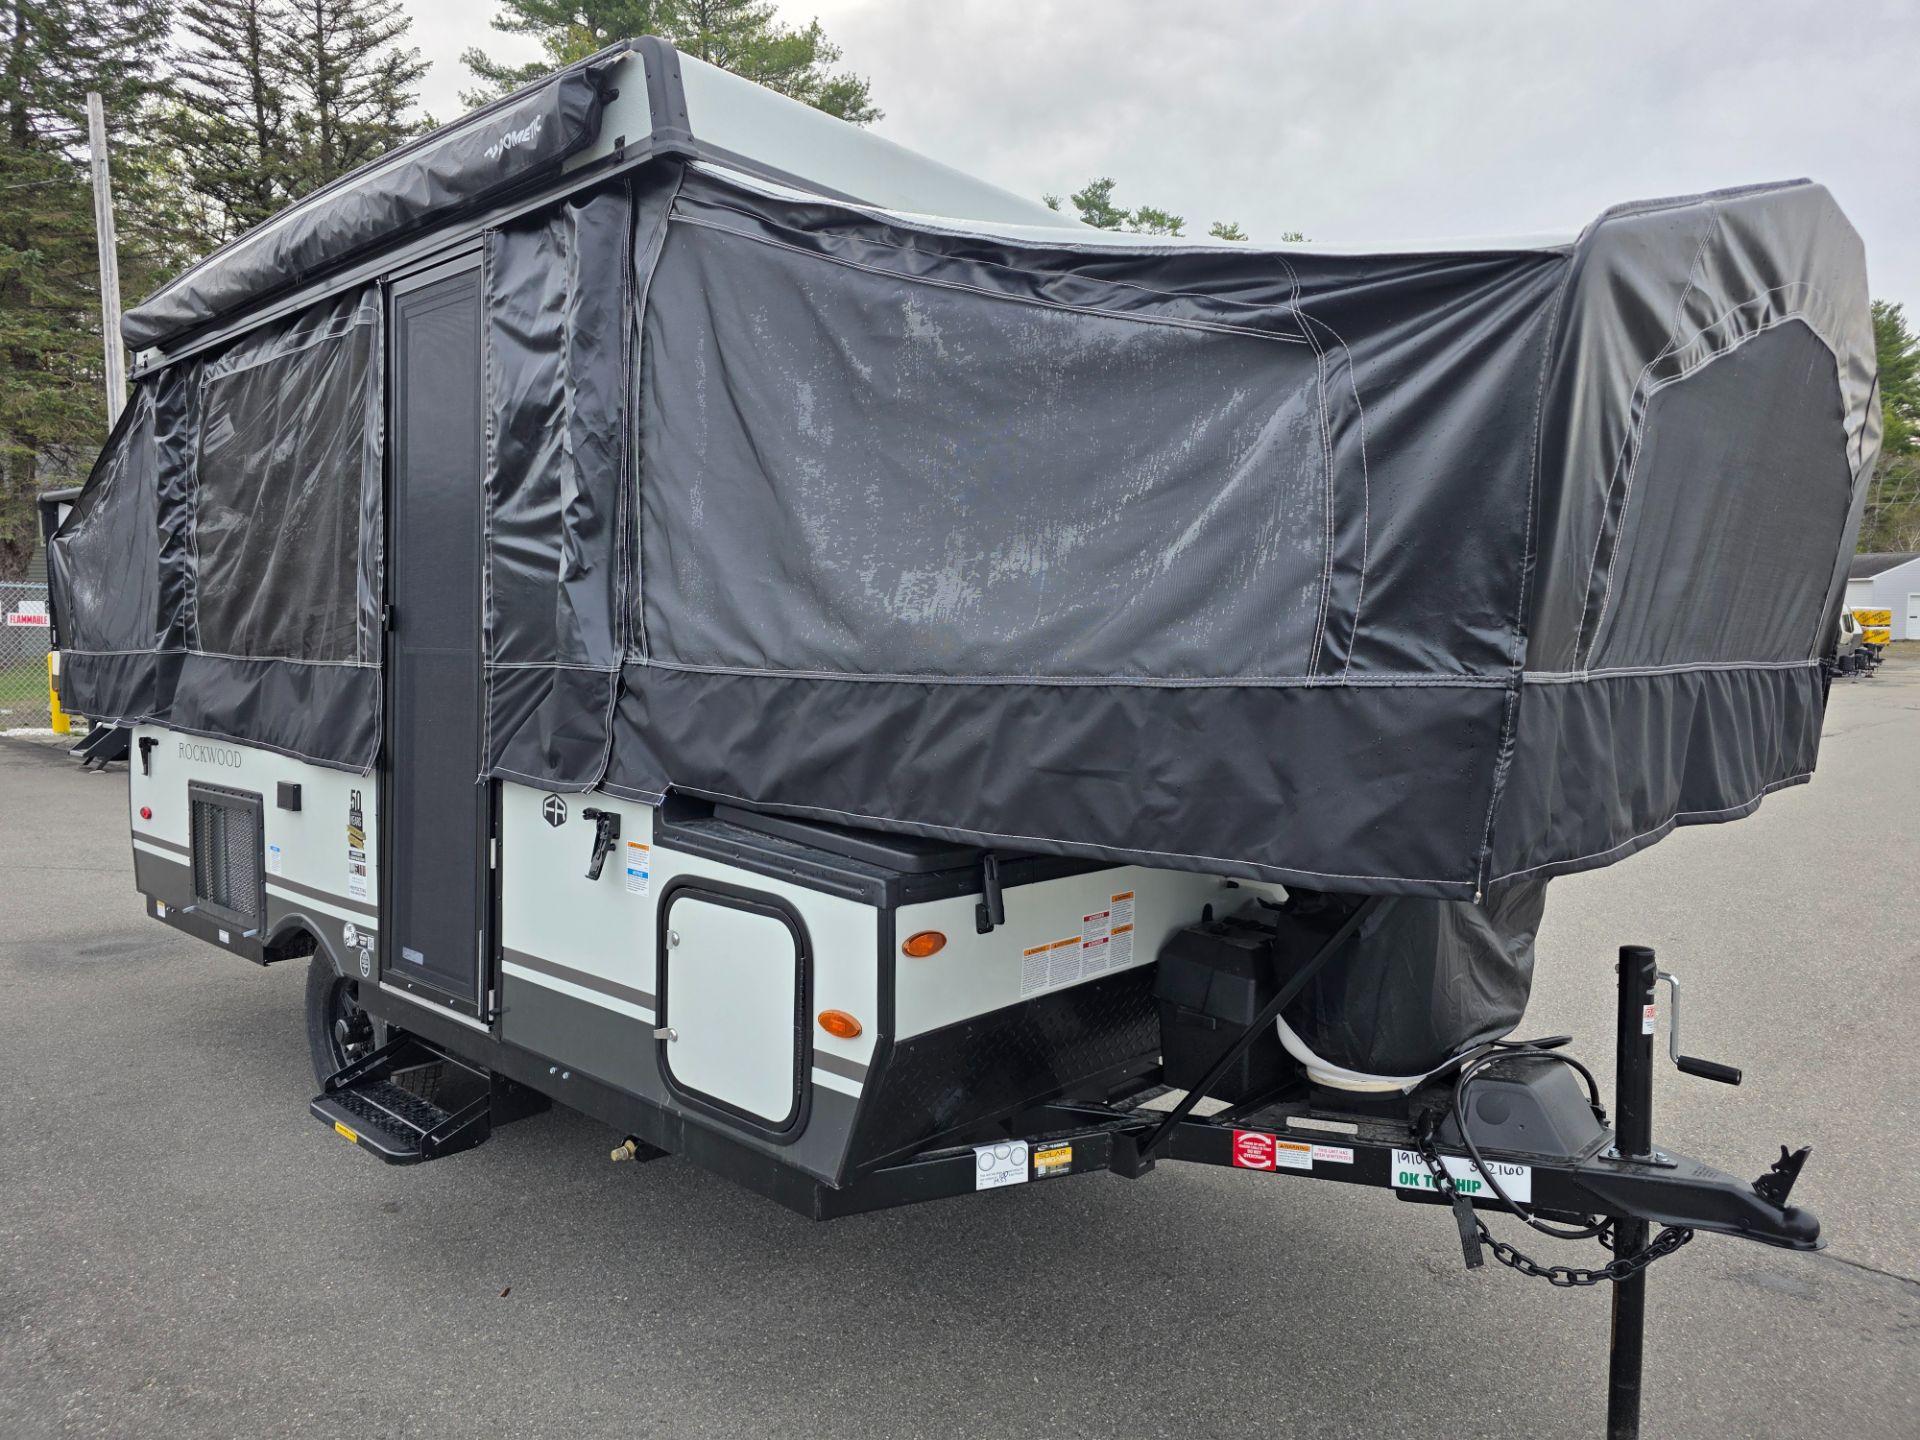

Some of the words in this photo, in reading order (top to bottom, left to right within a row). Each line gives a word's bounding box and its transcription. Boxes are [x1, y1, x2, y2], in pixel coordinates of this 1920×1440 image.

[10, 615, 48, 625] FLAMMABLE
[179, 742, 242, 768] ROCKWOOD
[350, 789, 362, 812] 50
[1039, 1150, 1067, 1159] SOLAR
[1468, 1159, 1524, 1176] 32160
[1399, 1171, 1420, 1186] OK
[1455, 1178, 1482, 1193] HIP
